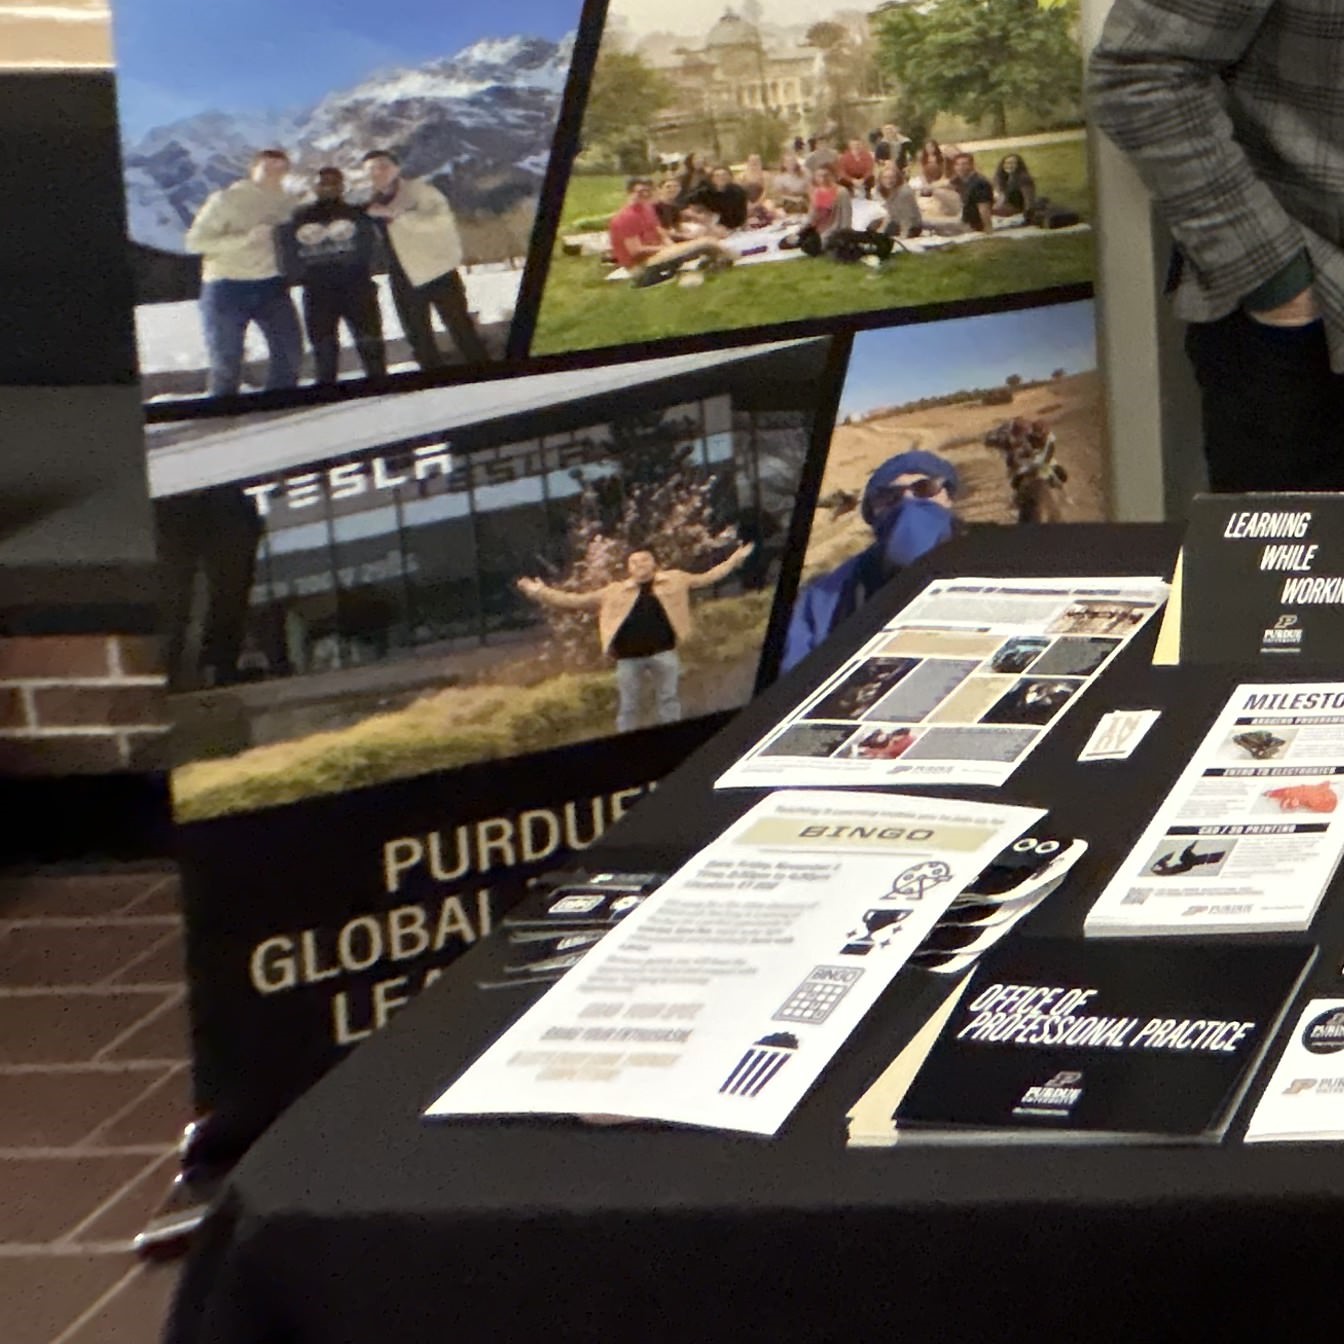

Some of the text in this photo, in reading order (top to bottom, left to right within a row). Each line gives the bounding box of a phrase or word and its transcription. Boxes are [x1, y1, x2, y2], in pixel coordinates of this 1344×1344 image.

[243, 442, 454, 517] TESLA
[1224, 512, 1312, 539] LEARNING
[1260, 544, 1319, 571] WHILE
[798, 825, 936, 842] BINGO
[811, 969, 858, 982] BINGO
[969, 983, 1100, 1015] OFFICE OF
[958, 1011, 1255, 1053] PROFESSIONAL PRACTICE
[1024, 1086, 1083, 1099] PURDUE
